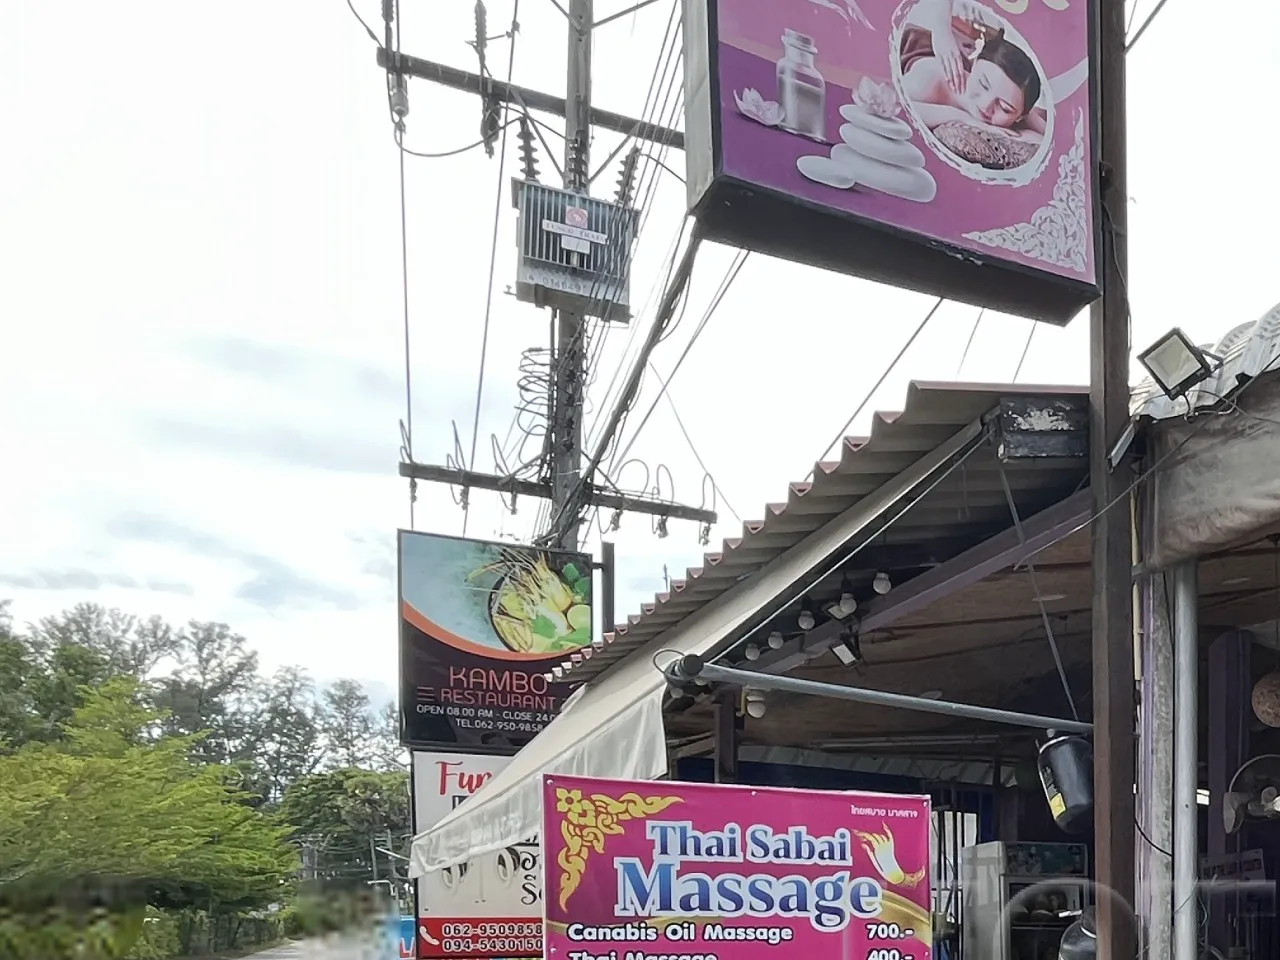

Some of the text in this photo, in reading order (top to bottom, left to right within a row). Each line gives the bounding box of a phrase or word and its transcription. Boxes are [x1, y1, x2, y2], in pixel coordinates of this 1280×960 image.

[449, 666, 548, 695] KAMBO
[441, 689, 557, 710] RESTAURANT
[417, 703, 444, 715] OPEN
[446, 706, 475, 718] 08.00
[478, 709, 493, 718] AM
[503, 711, 532, 721] CLOSE
[648, 822, 851, 864] Thai Sabai
[616, 858, 881, 929] Massage
[443, 924, 543, 936] 062-9509858
[568, 922, 914, 944] Canabis Oil Massage 700.-
[444, 939, 543, 952] 094-5430150
